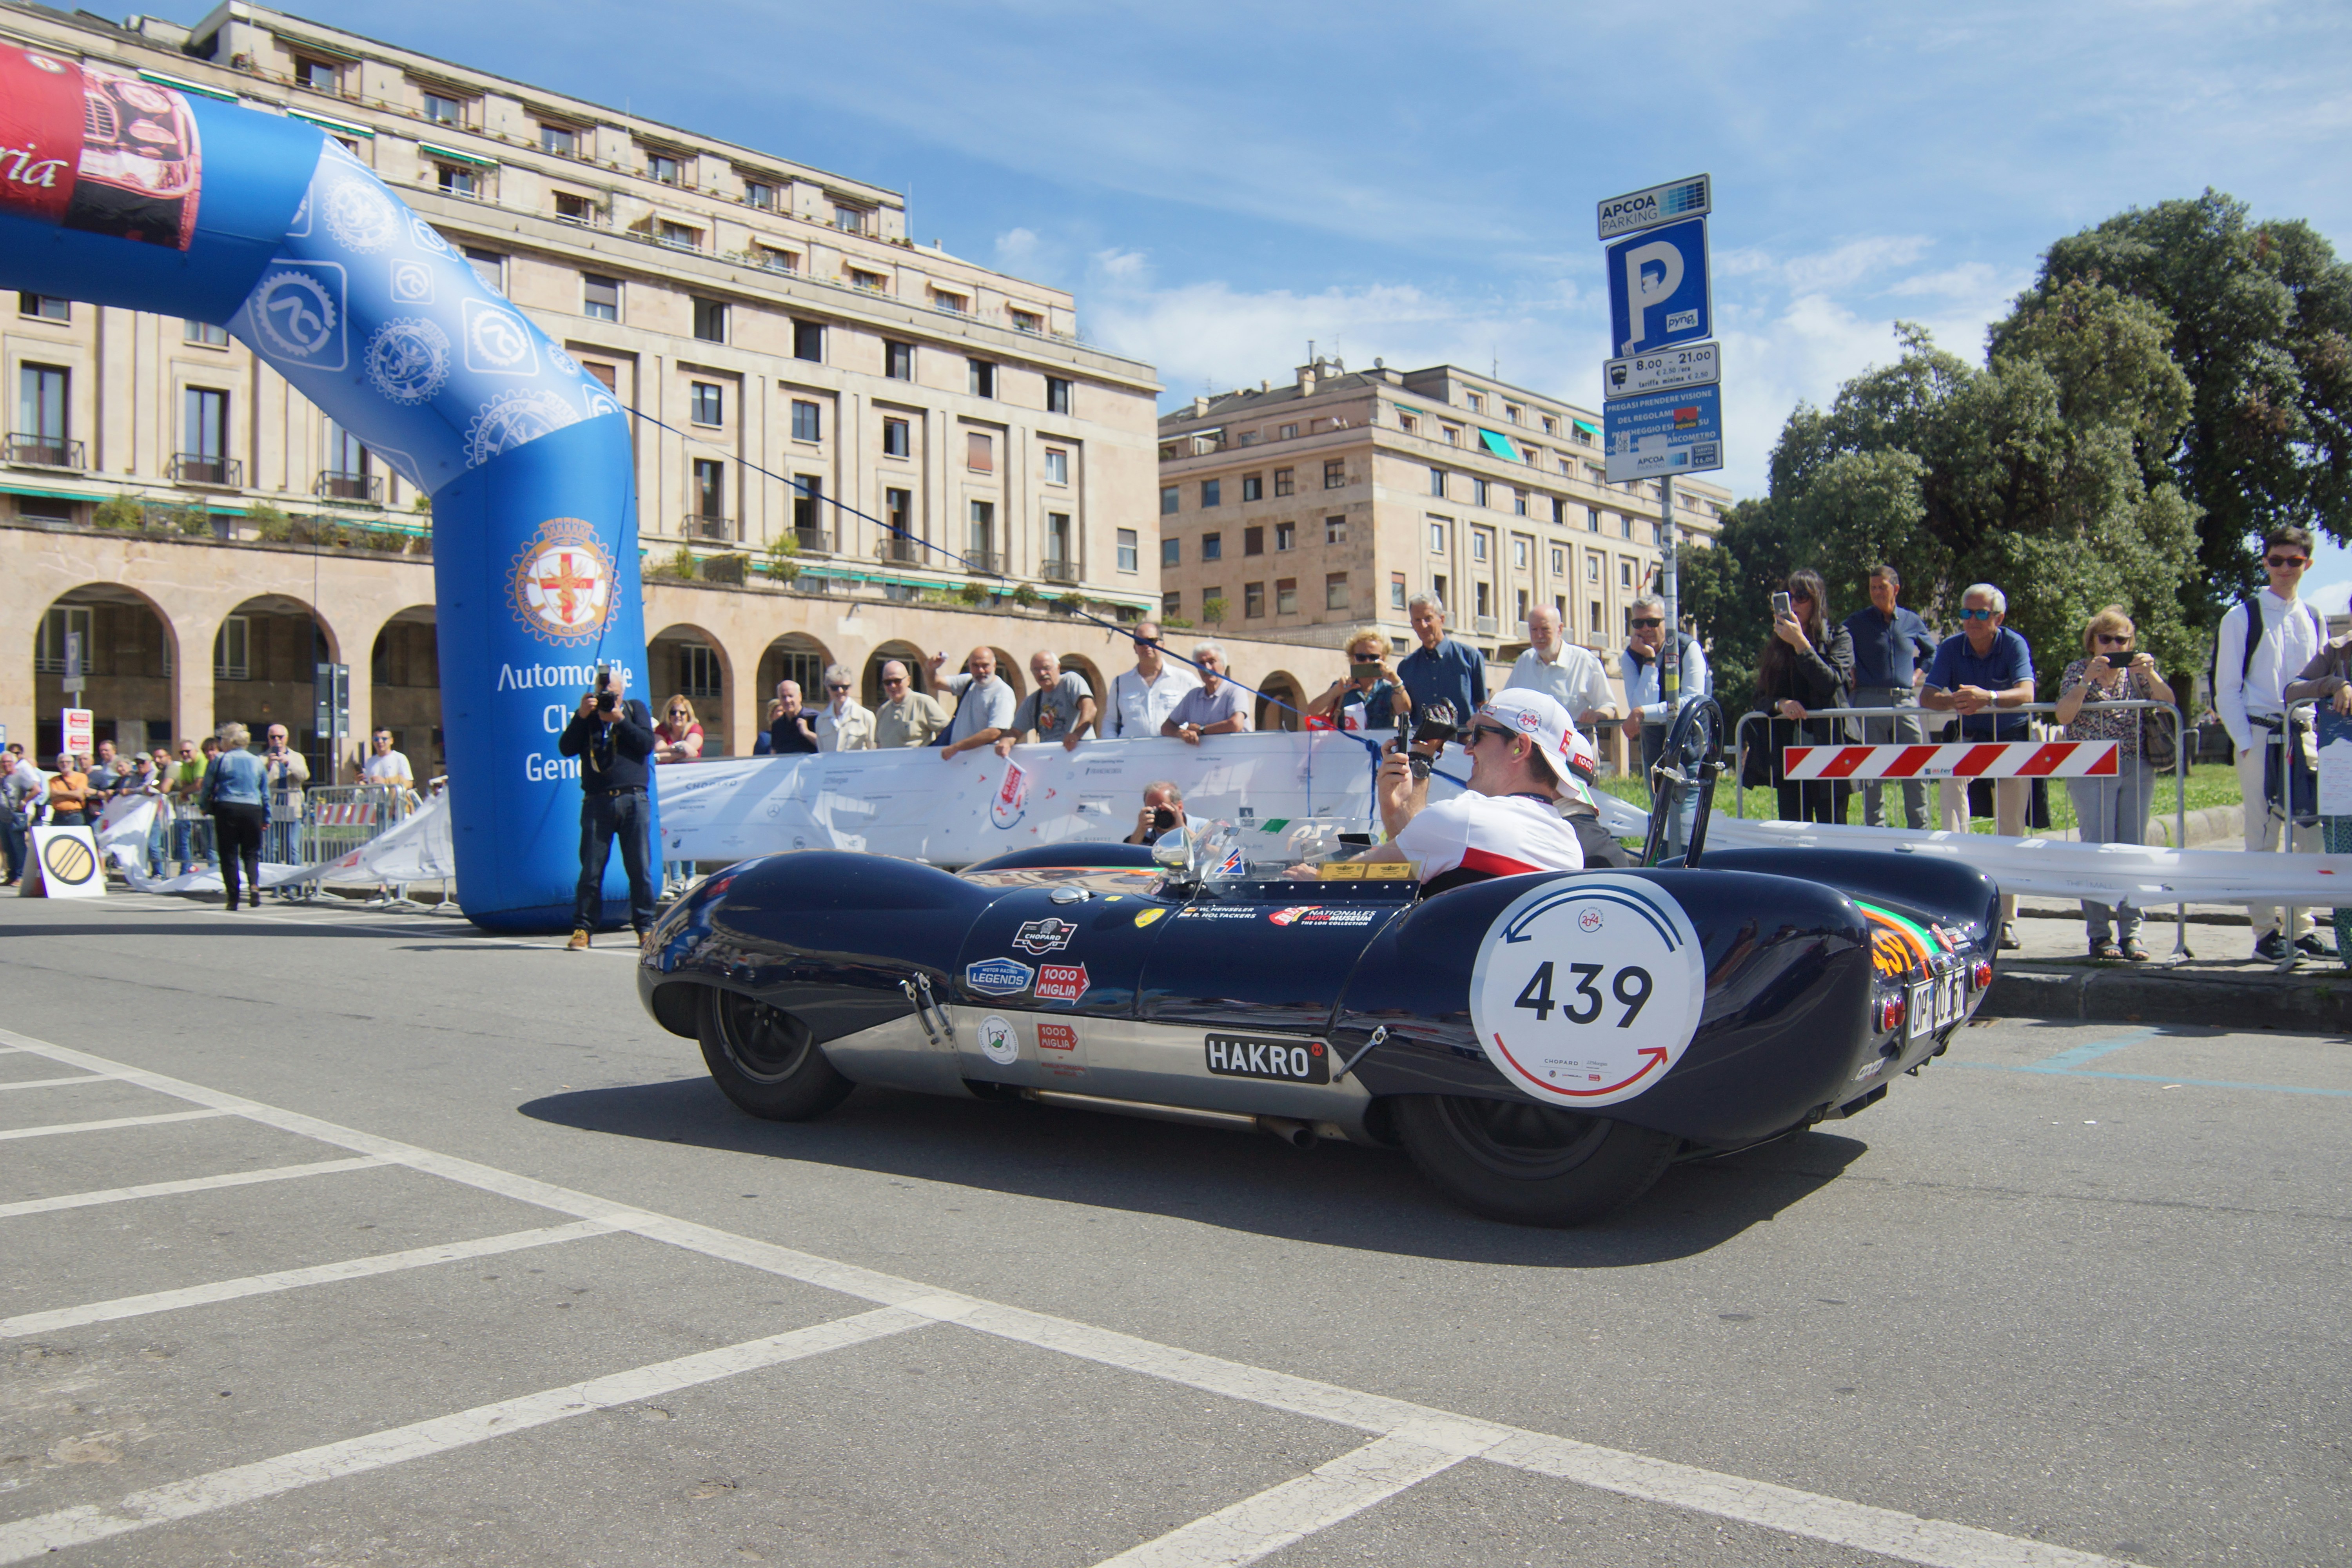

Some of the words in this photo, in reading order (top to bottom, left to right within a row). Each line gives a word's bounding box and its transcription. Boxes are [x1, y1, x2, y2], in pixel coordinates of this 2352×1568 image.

[1602, 195, 1656, 220] APCOA
[1602, 208, 1657, 232] PARKING
[1625, 241, 1684, 346] P
[1636, 359, 1662, 371] 8.00
[1678, 351, 1711, 364] 21.00
[1639, 379, 1659, 388] tariffa
[1662, 375, 1684, 384] minima
[1607, 402, 1639, 412] PREGASI
[1640, 395, 1679, 407] PRENDERE
[1681, 390, 1712, 401] VISIONE
[1618, 416, 1631, 425] DEL
[1699, 418, 1710, 426] SU
[1667, 431, 1716, 444] ARCOMETRO
[1638, 455, 1664, 465] APCOA
[517, 550, 556, 632] AUTOMOBILE
[560, 620, 597, 634] CLUB
[1582, 913, 1599, 927] 2024
[972, 973, 1024, 985] LEGENDS
[1044, 969, 1077, 981] 1000
[1038, 983, 1076, 996] MIGLIA
[1514, 961, 1653, 1029] 439
[1042, 1026, 1067, 1036] 1000
[1041, 1038, 1070, 1048] MIGLIA
[1209, 1040, 1309, 1077] HAKRO
